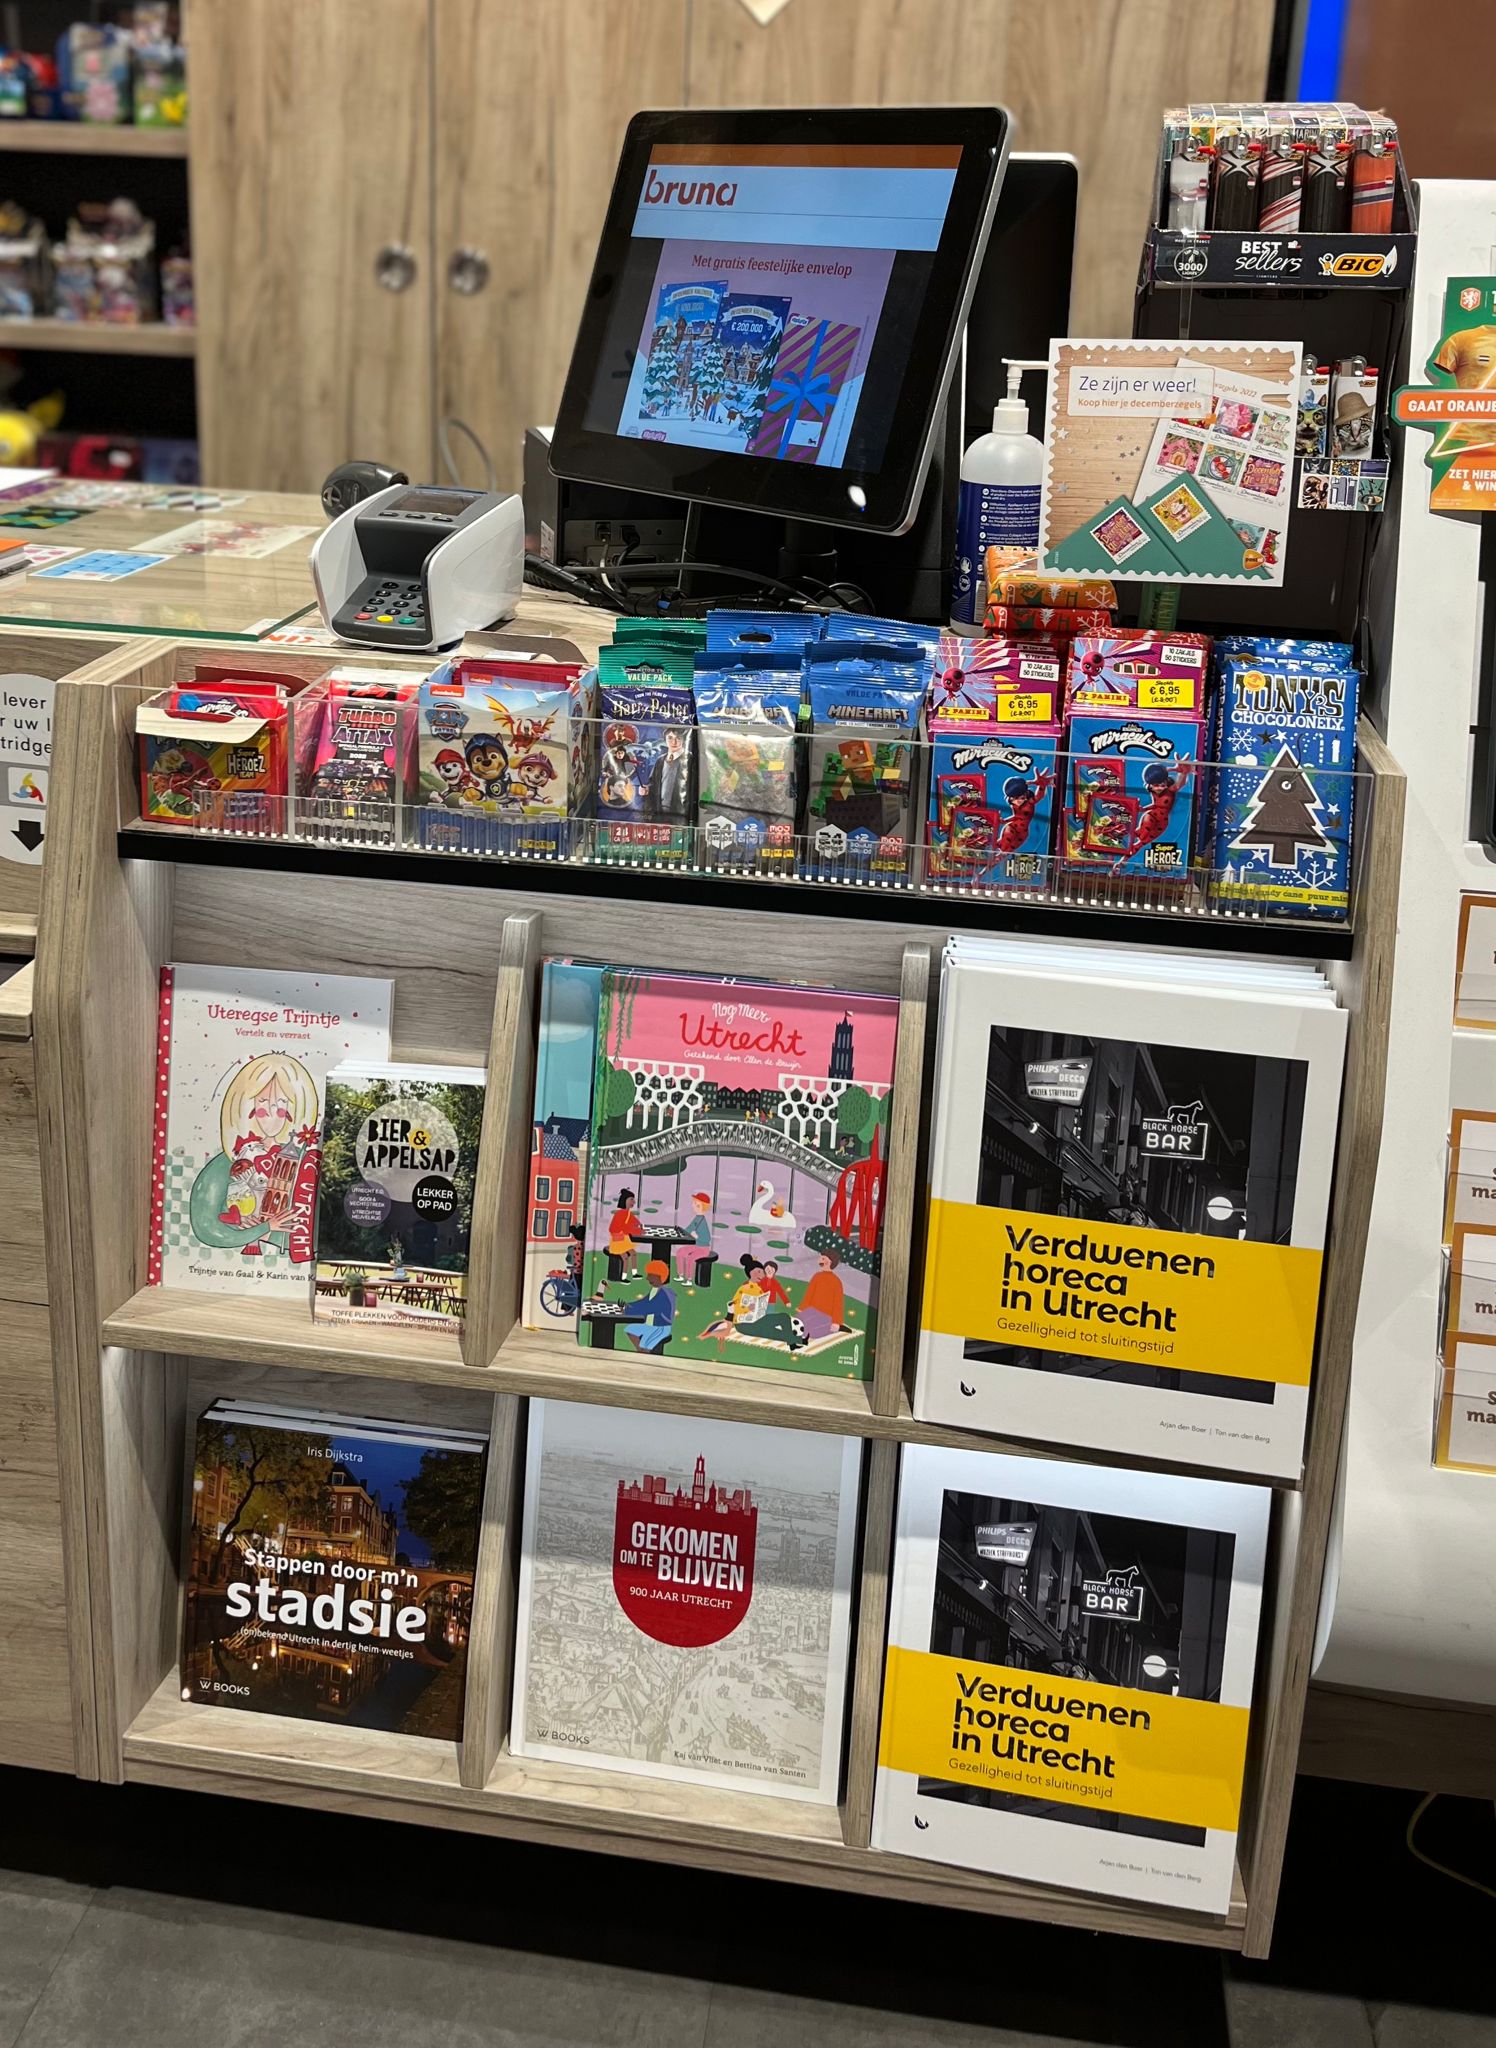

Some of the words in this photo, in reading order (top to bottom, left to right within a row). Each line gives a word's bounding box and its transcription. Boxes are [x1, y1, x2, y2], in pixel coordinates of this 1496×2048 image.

[643, 170, 738, 206] bruna
[1241, 241, 1283, 254] BEST
[691, 255, 711, 268] Met
[713, 256, 746, 271] gratis
[747, 257, 804, 275] feestelijke
[806, 262, 853, 279] envelop
[1178, 262, 1203, 272] 3000
[1234, 250, 1303, 272] sellers
[1079, 376, 1099, 391] Ze
[1102, 377, 1129, 395] zijn
[1133, 380, 1149, 391] er
[1153, 378, 1196, 393] weer!
[1078, 398, 1101, 408] Koop
[1102, 398, 1119, 408] hier
[1120, 399, 1129, 409] je
[1130, 399, 1202, 410] decemberzegels
[1408, 400, 1444, 412] GAAT
[1449, 469, 1469, 479] ZET
[1472, 469, 1496, 480] HIER
[1463, 481, 1471, 490] &
[1173, 656, 1197, 664] STICKERS
[627, 673, 650, 682] VALUE
[653, 674, 673, 682] PACK
[4, 691, 47, 709] lever
[1150, 686, 1156, 695] €
[1159, 686, 1180, 696] 6,95
[612, 700, 649, 720] Harry
[650, 698, 689, 718] Potter
[828, 704, 909, 721] MINECRAFT
[1018, 700, 1038, 710] 6,95
[14, 718, 38, 730] uw
[339, 708, 397, 725] TURBO
[331, 726, 394, 747] ATTAX
[1155, 844, 1174, 852] Super
[1145, 849, 1182, 868] HEROEZ
[1308, 893, 1329, 901] puur
[207, 1004, 278, 1025] Uteregse
[283, 1008, 340, 1026] Trijntje
[712, 1002, 737, 1024] Nog
[235, 1027, 264, 1038] Vertelt
[266, 1031, 278, 1039] en
[279, 1031, 311, 1040] verrast
[679, 1013, 806, 1056] Utrecht
[684, 1050, 721, 1060] Getekend
[724, 1054, 741, 1063] door
[744, 1055, 762, 1065] Ellen
[1028, 1064, 1059, 1073] PHILIPS
[368, 1118, 410, 1143] BIER
[413, 1130, 427, 1146] &
[1142, 1121, 1168, 1132] BLACK
[1170, 1123, 1198, 1135] HORSE
[1146, 1134, 1192, 1151] BAR
[363, 1145, 456, 1172] APPELSAP
[417, 1187, 454, 1199] LEKKER
[417, 1199, 431, 1209] OP
[433, 1201, 452, 1211] PAD
[293, 1182, 315, 1256] UTRECHT
[1005, 1224, 1215, 1280] Verdwenen
[188, 1265, 217, 1277] Trijntje
[219, 1269, 234, 1277] van
[235, 1267, 254, 1278] Gaal
[257, 1269, 264, 1279] &
[266, 1269, 288, 1281] Karin
[291, 1273, 306, 1281] van
[1003, 1253, 1128, 1296] horeca
[1000, 1281, 1032, 1312] in
[1044, 1288, 1177, 1333] Utrecht
[332, 1310, 353, 1318] TOFFE
[355, 1311, 386, 1320] PLEKKEN
[388, 1313, 407, 1321] VOOR
[409, 1316, 436, 1325] OUDERS
[996, 1317, 1077, 1341] Gezelligheid
[1080, 1330, 1098, 1344] tot
[1100, 1332, 1175, 1356] sluitingstijd
[1160, 1420, 1176, 1429] Arjan
[1192, 1425, 1206, 1433] Boer
[1215, 1428, 1226, 1436] Ton
[1255, 1435, 1270, 1444] Berg
[307, 1446, 322, 1458] Iris
[325, 1449, 363, 1463] Dijkstra
[977, 1526, 1007, 1536] PHILIPS
[631, 1520, 738, 1561] GEKOMEN
[244, 1548, 325, 1576] Stappen
[331, 1560, 375, 1581] door
[620, 1549, 637, 1565] OM
[641, 1552, 653, 1568] TE
[657, 1554, 745, 1592] BLIJVEN
[629, 1587, 648, 1598] 900
[650, 1589, 679, 1603] JAAR
[681, 1593, 733, 1610] UTRECHT
[1083, 1583, 1107, 1594] BLACK
[1109, 1586, 1134, 1597] HORSE
[226, 1578, 427, 1643] stadsie
[1086, 1594, 1129, 1612] BAR
[240, 1626, 288, 1641] (on)bekend
[289, 1634, 320, 1646] Utrecht
[322, 1638, 330, 1646] in
[331, 1639, 357, 1653] dertig
[200, 1680, 211, 1690] W
[213, 1682, 250, 1696] BOOKS
[956, 1672, 1151, 1730] Verdwenen
[953, 1699, 1070, 1743] horeca
[537, 1729, 548, 1739] W
[551, 1731, 590, 1745] BOOKS
[952, 1724, 981, 1752] in
[991, 1733, 1115, 1779] Utrecht
[674, 1750, 686, 1762] Kaj
[688, 1753, 702, 1762] van
[703, 1754, 721, 1765] Vliet
[723, 1758, 732, 1767] en
[734, 1759, 762, 1772] Bettina
[763, 1765, 777, 1774] van
[779, 1765, 806, 1778] Santen
[948, 1757, 1023, 1782] Gezelligheid
[1025, 1774, 1042, 1787] tot
[1045, 1776, 1113, 1799] sluitingstijd
